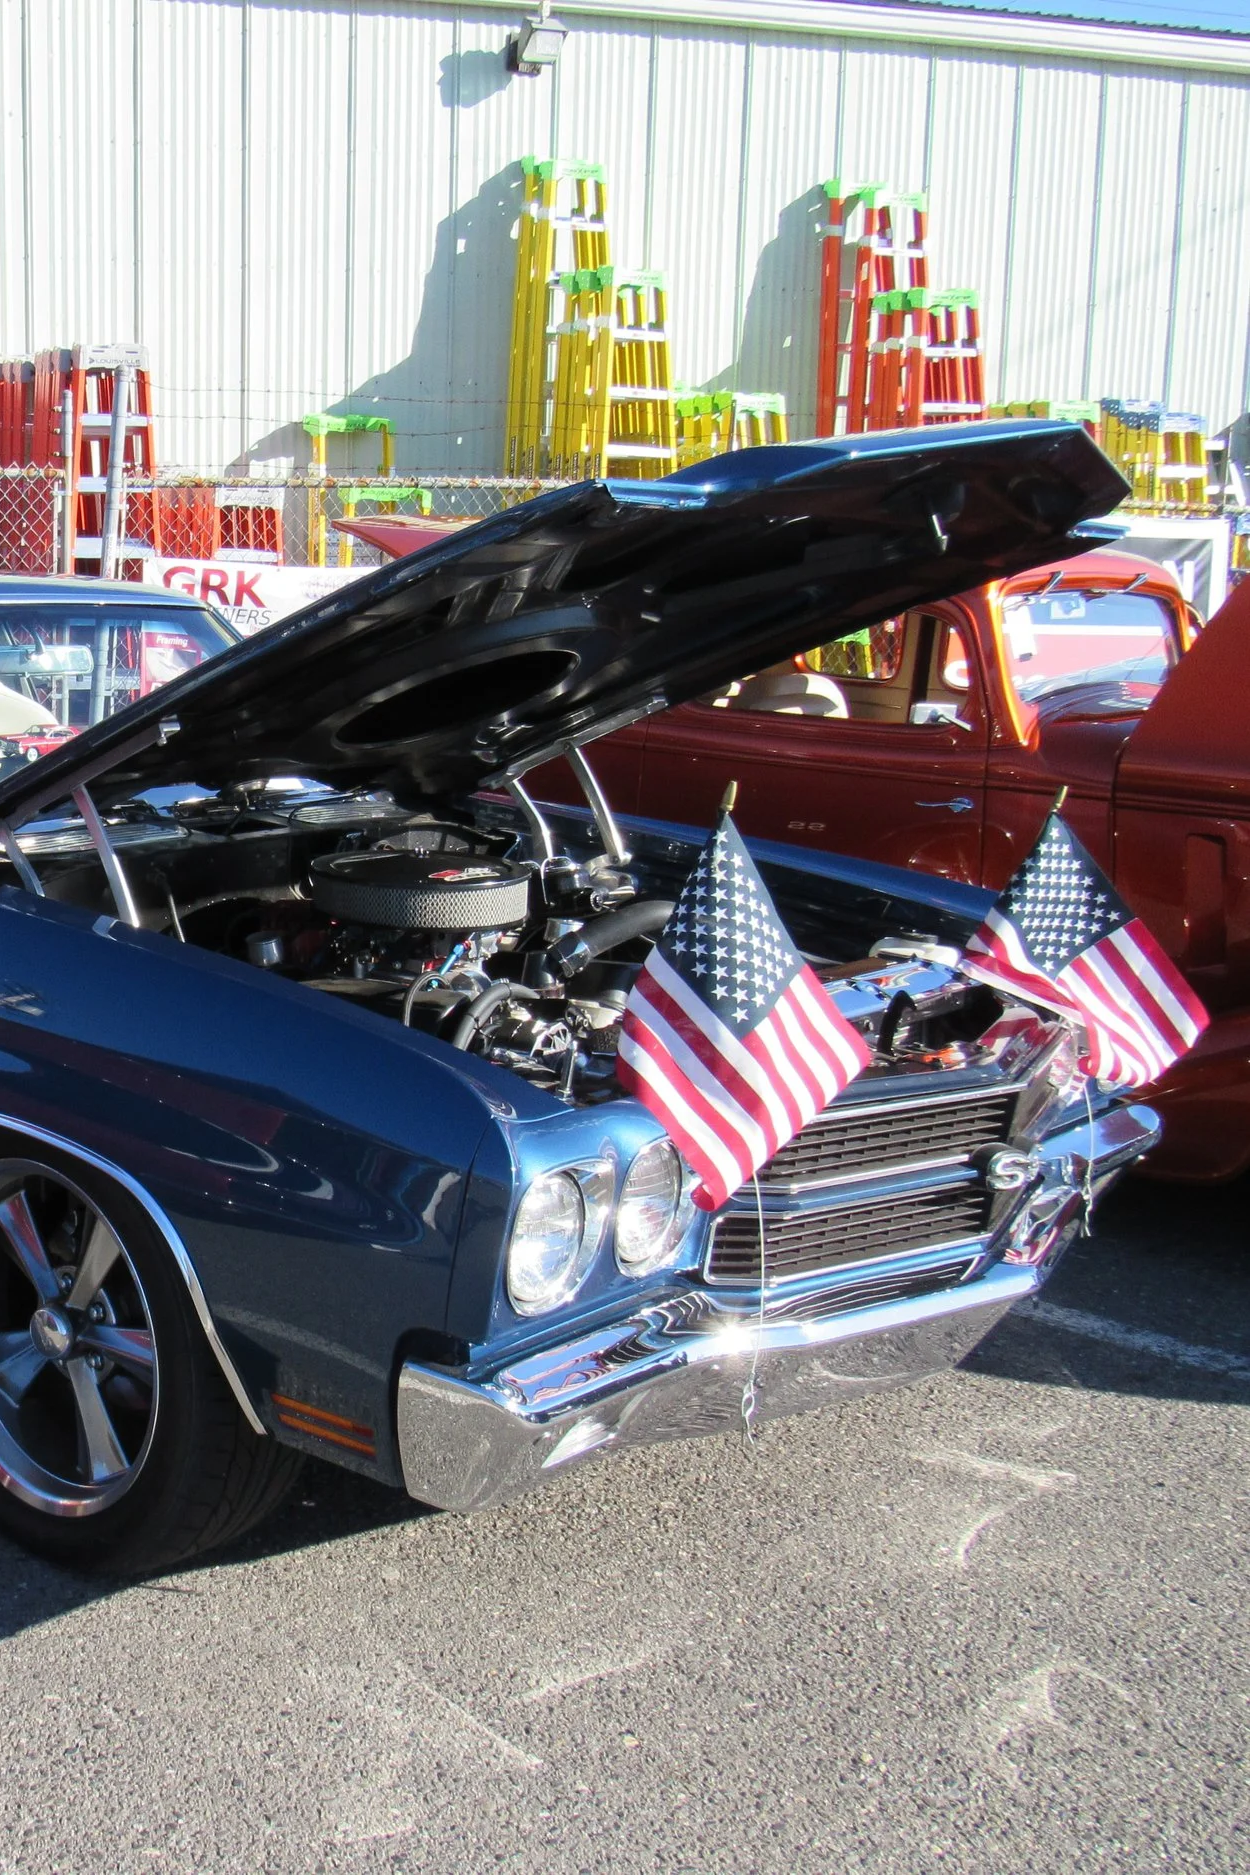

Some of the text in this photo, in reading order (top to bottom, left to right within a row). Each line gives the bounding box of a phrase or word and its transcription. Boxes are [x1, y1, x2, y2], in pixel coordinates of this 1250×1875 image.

[163, 566, 266, 608] GRK
[217, 606, 272, 626] NERS
[156, 635, 188, 647] Framing
